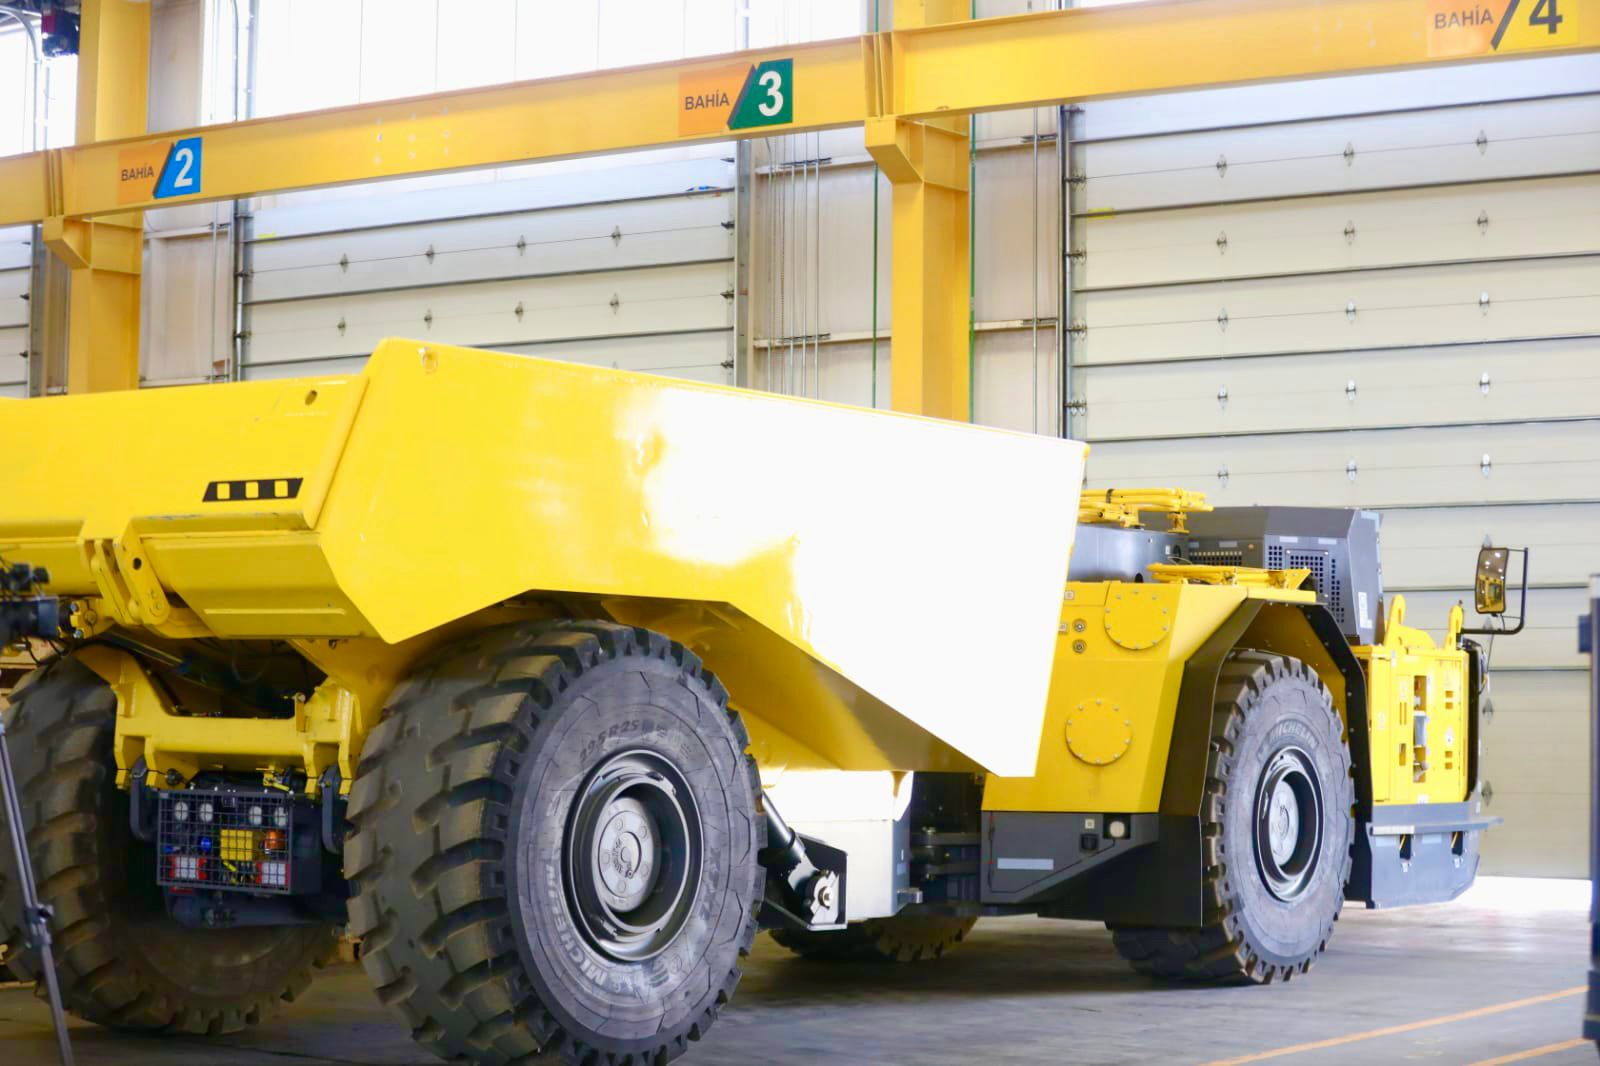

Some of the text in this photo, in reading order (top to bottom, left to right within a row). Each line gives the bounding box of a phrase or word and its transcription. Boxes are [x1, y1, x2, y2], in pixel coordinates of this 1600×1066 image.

[1434, 0, 1563, 34] BAHÍA 4
[684, 71, 784, 117] BAHÍA 3
[174, 147, 194, 188] 2
[1267, 720, 1317, 750] MICHELIN
[546, 863, 608, 986] MICHELIN
